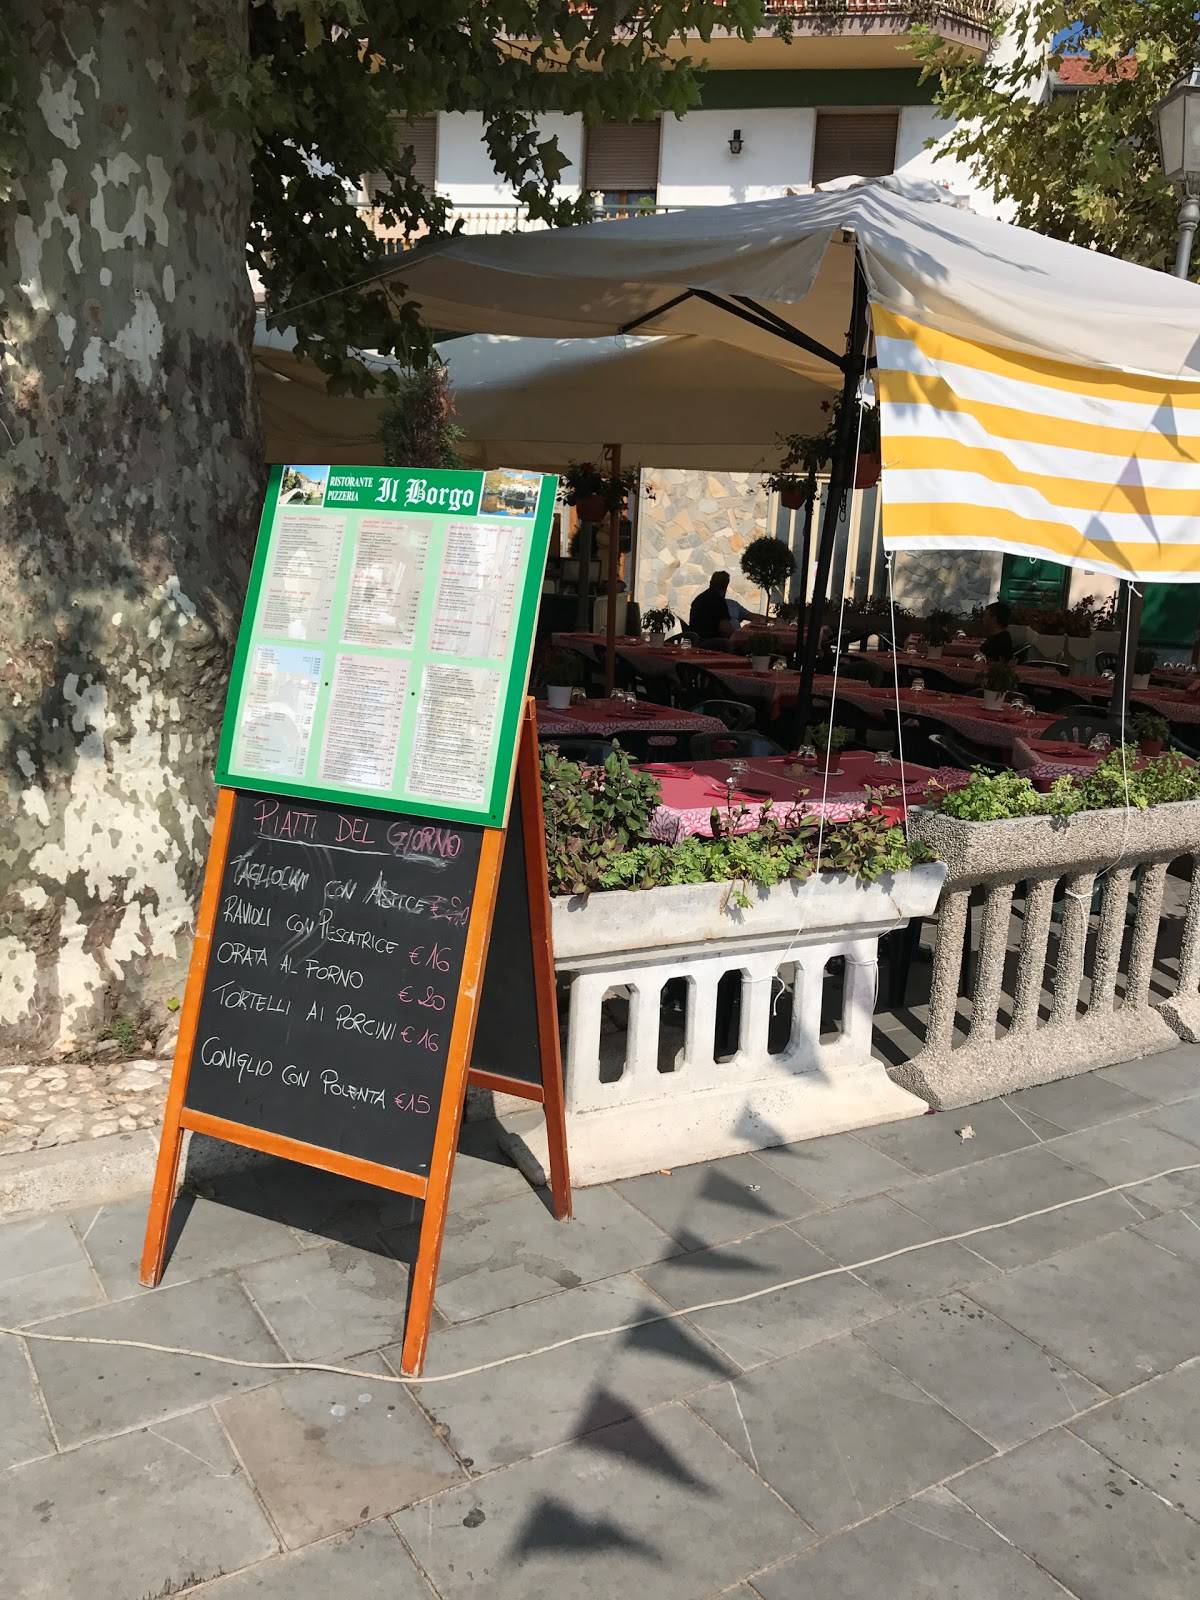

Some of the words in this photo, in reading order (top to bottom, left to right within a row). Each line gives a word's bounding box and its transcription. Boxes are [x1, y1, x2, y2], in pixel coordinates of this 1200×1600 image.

[327, 490, 359, 502] PIZZERIA
[329, 476, 374, 488] RISTORANTE
[375, 477, 400, 503] Il
[404, 478, 475, 511] Borgo
[253, 799, 318, 839] PIATTI
[335, 814, 376, 844] DEL
[386, 821, 462, 858] GIORNO
[323, 879, 357, 901] CON
[223, 895, 271, 927] RAVIOLI
[286, 913, 315, 937] CON
[319, 907, 399, 954] PESCATRICE
[217, 942, 268, 967] ORATA
[280, 954, 298, 975] AL
[306, 959, 364, 989] FORNO
[212, 980, 291, 1015] TORTELLI
[306, 1001, 324, 1023] AI
[336, 1004, 397, 1041] PORCINI
[201, 1036, 273, 1084] CONIGLIO
[281, 1064, 310, 1088] CON
[320, 1069, 386, 1109] POLENTA
